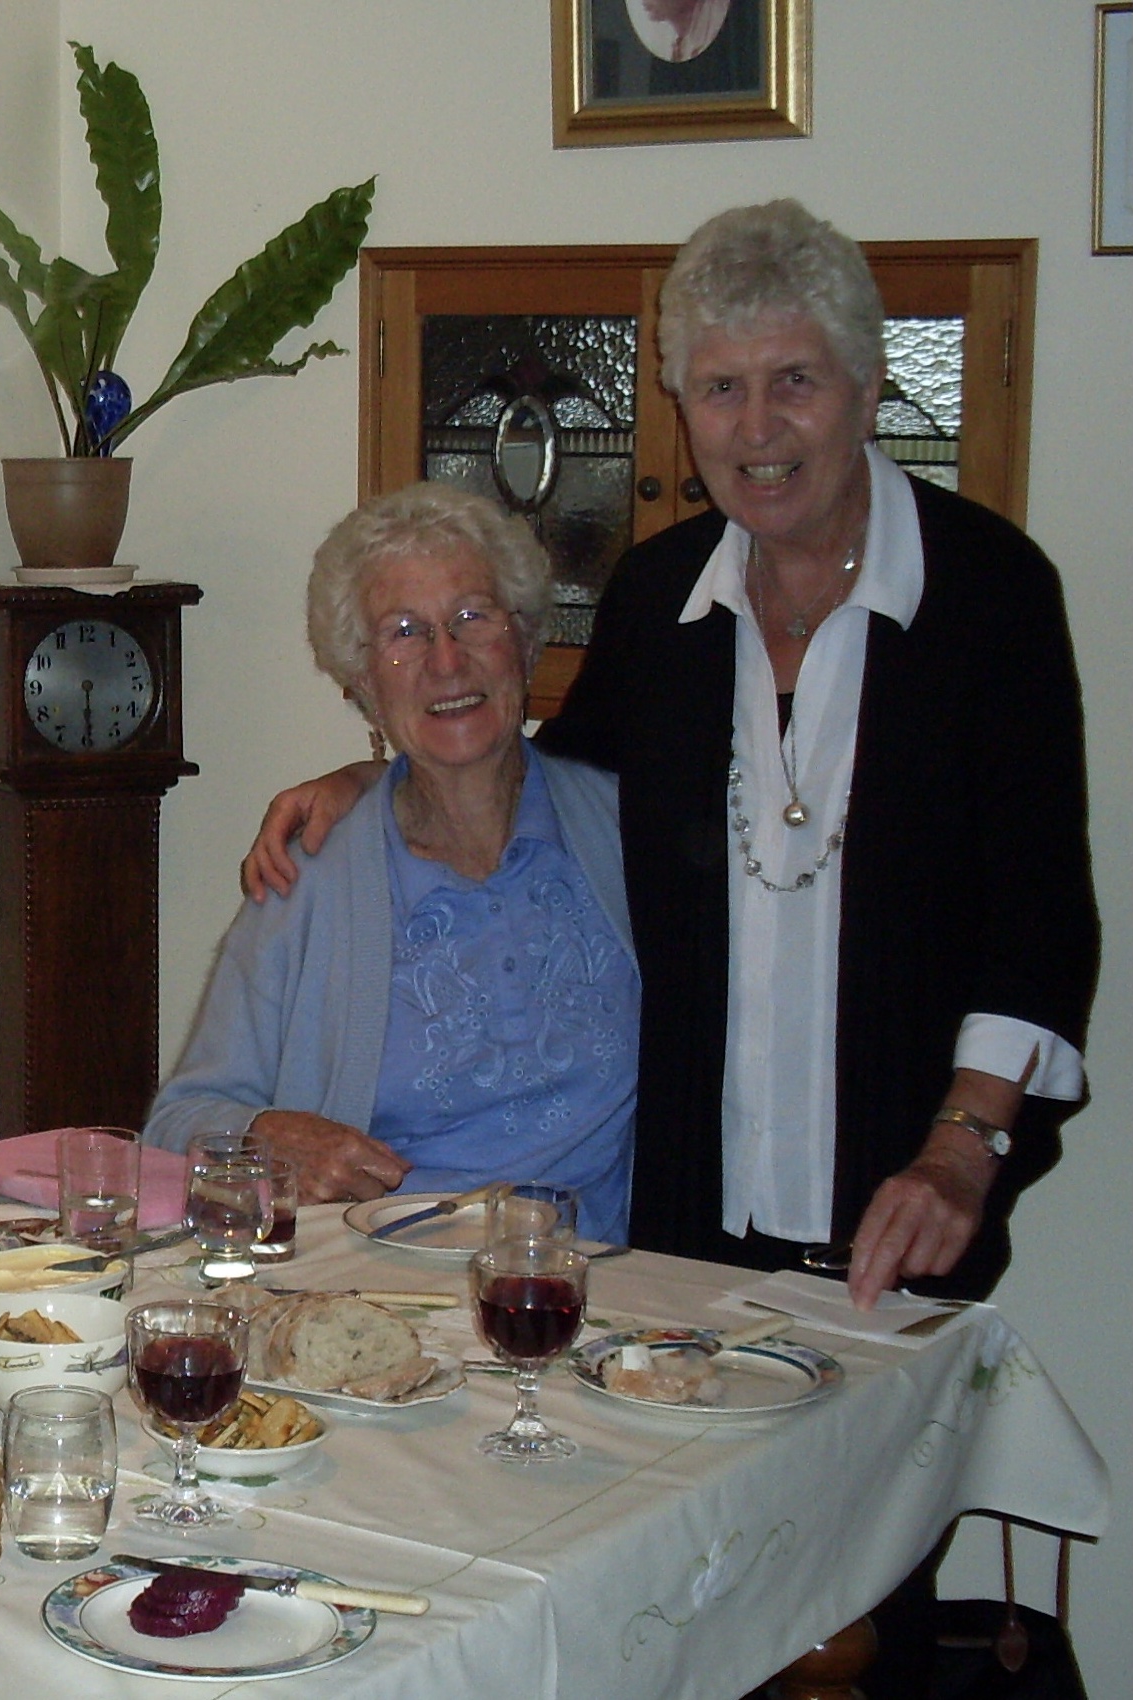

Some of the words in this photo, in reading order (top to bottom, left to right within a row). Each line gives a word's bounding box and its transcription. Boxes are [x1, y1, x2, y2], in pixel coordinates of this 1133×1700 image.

[79, 624, 95, 643] 12
[110, 630, 115, 648] 1
[36, 654, 51, 671] 10
[125, 650, 136, 667] 2
[29, 679, 43, 696] 9
[37, 705, 50, 723] 8
